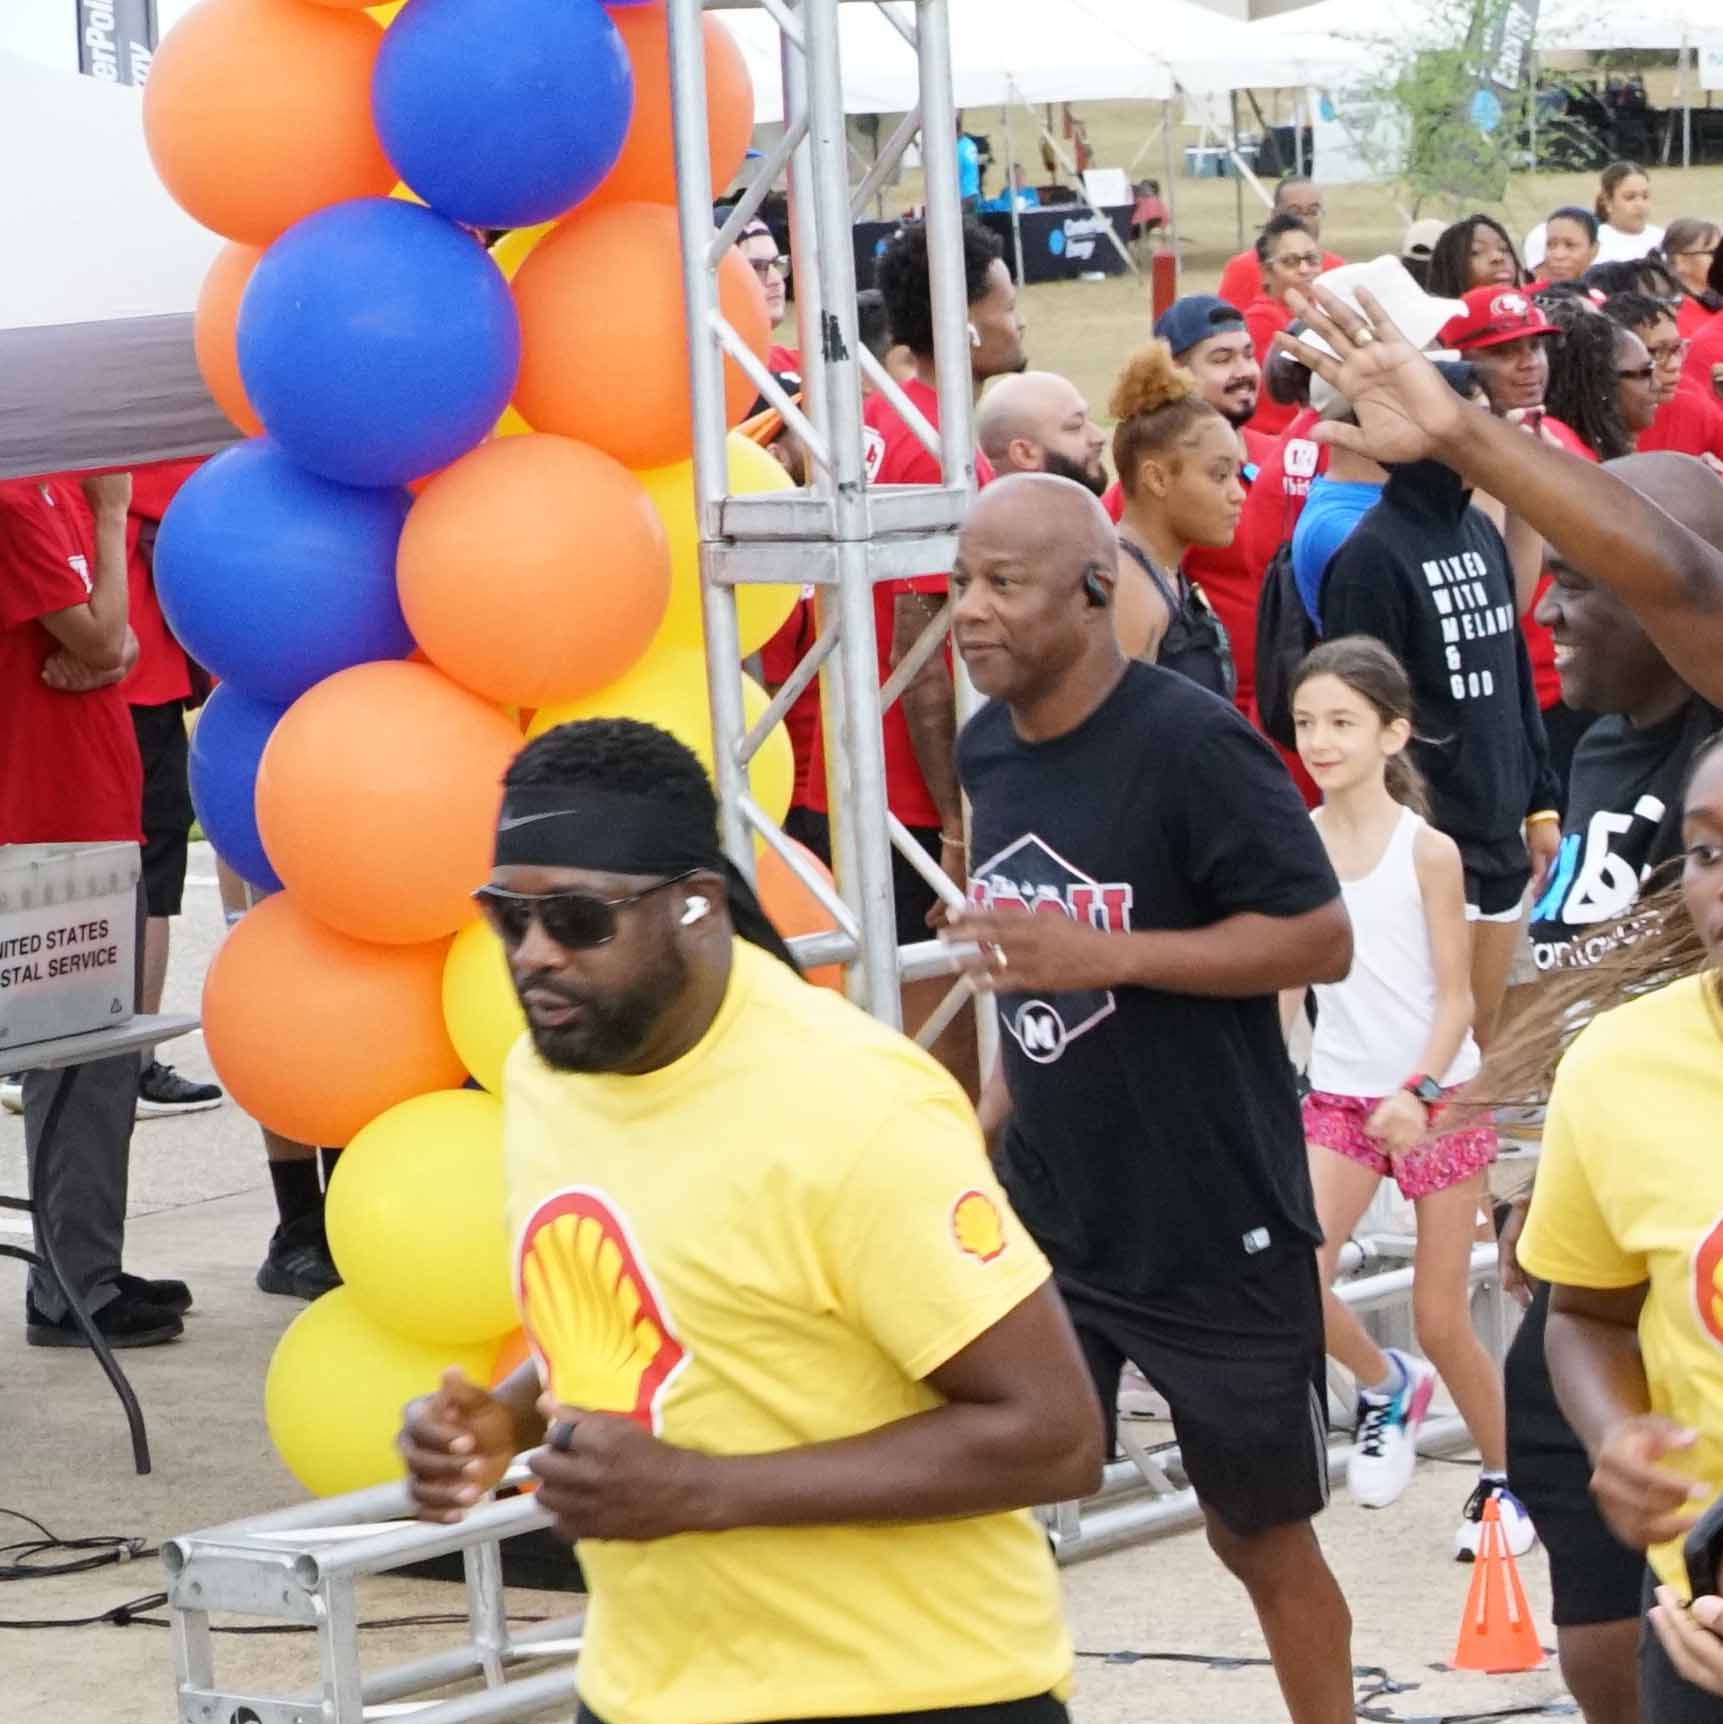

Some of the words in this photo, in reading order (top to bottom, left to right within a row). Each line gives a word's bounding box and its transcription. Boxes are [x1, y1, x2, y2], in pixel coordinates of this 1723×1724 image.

[1422, 551, 1488, 587] MIXED
[1432, 581, 1489, 615] WITH
[1450, 670, 1494, 700] GOD
[0, 934, 41, 960] ITED
[46, 920, 108, 949] STATES
[48, 946, 117, 977] SERVICE
